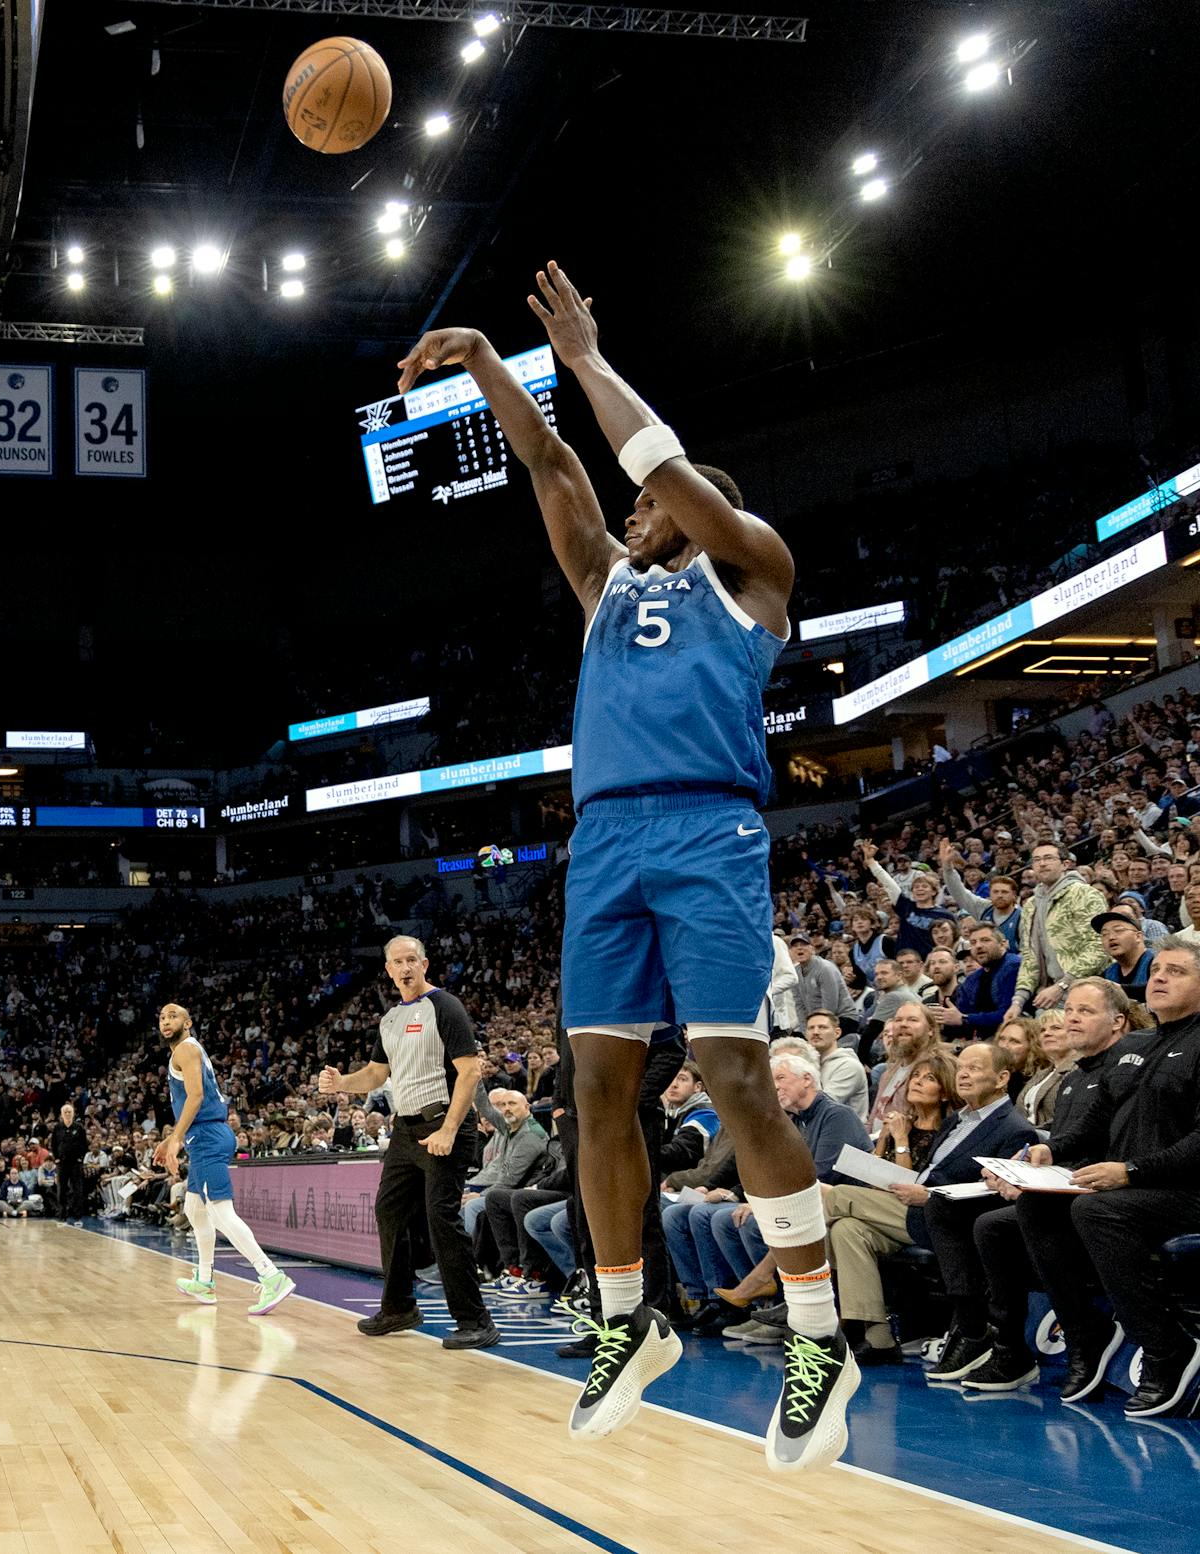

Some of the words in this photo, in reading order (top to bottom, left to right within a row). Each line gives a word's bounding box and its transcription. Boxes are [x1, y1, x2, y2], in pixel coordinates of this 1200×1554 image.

[83, 402, 138, 446] 34
[465, 416, 471, 425] 7
[467, 427, 473, 436] 4
[481, 423, 487, 432] 2
[381, 431, 429, 452] Wembanyama
[469, 439, 475, 448] 2
[483, 435, 489, 443] 0
[496, 430, 503, 439] 0
[87, 449, 135, 465] FOWLES
[384, 448, 414, 463] Johnson
[457, 454, 467, 462] 10
[485, 446, 491, 454] 0
[386, 460, 411, 473] Osman
[460, 464, 469, 474] 12
[473, 461, 479, 470] 5
[487, 457, 494, 466] 2
[500, 453, 507, 462] 0
[387, 469, 419, 484] Branham
[450, 477, 482, 493] Treasure
[482, 466, 507, 484] Island
[389, 481, 415, 495] Vassell
[1053, 548, 1139, 605] slumberland
[1066, 572, 1127, 609] FURNITURE
[634, 600, 671, 648] 5
[819, 608, 888, 629] slumberland
[942, 613, 1013, 661] slumberland
[953, 635, 1004, 666] FURNITURE
[853, 667, 911, 706] slumberland
[298, 717, 345, 733] slumberland
[21, 733, 73, 742] slumberland
[440, 756, 521, 780] slumberland
[452, 771, 509, 785] FURNITURE
[326, 777, 399, 799] slumberland
[336, 791, 389, 804] FURNITURE
[156, 809, 173, 818] DET
[175, 809, 188, 818] 76
[221, 795, 289, 818] slumberland
[156, 818, 175, 828] CHI
[175, 818, 189, 828] 69
[191, 814, 198, 824] 3
[230, 809, 279, 823] FURNITURE
[435, 856, 475, 873] Treasure
[517, 843, 548, 862] Island
[10, 890, 25, 899] 122
[1117, 1053, 1145, 1066] WOLVES
[323, 1191, 358, 1233] Believe
[775, 1217, 791, 1229] 5
